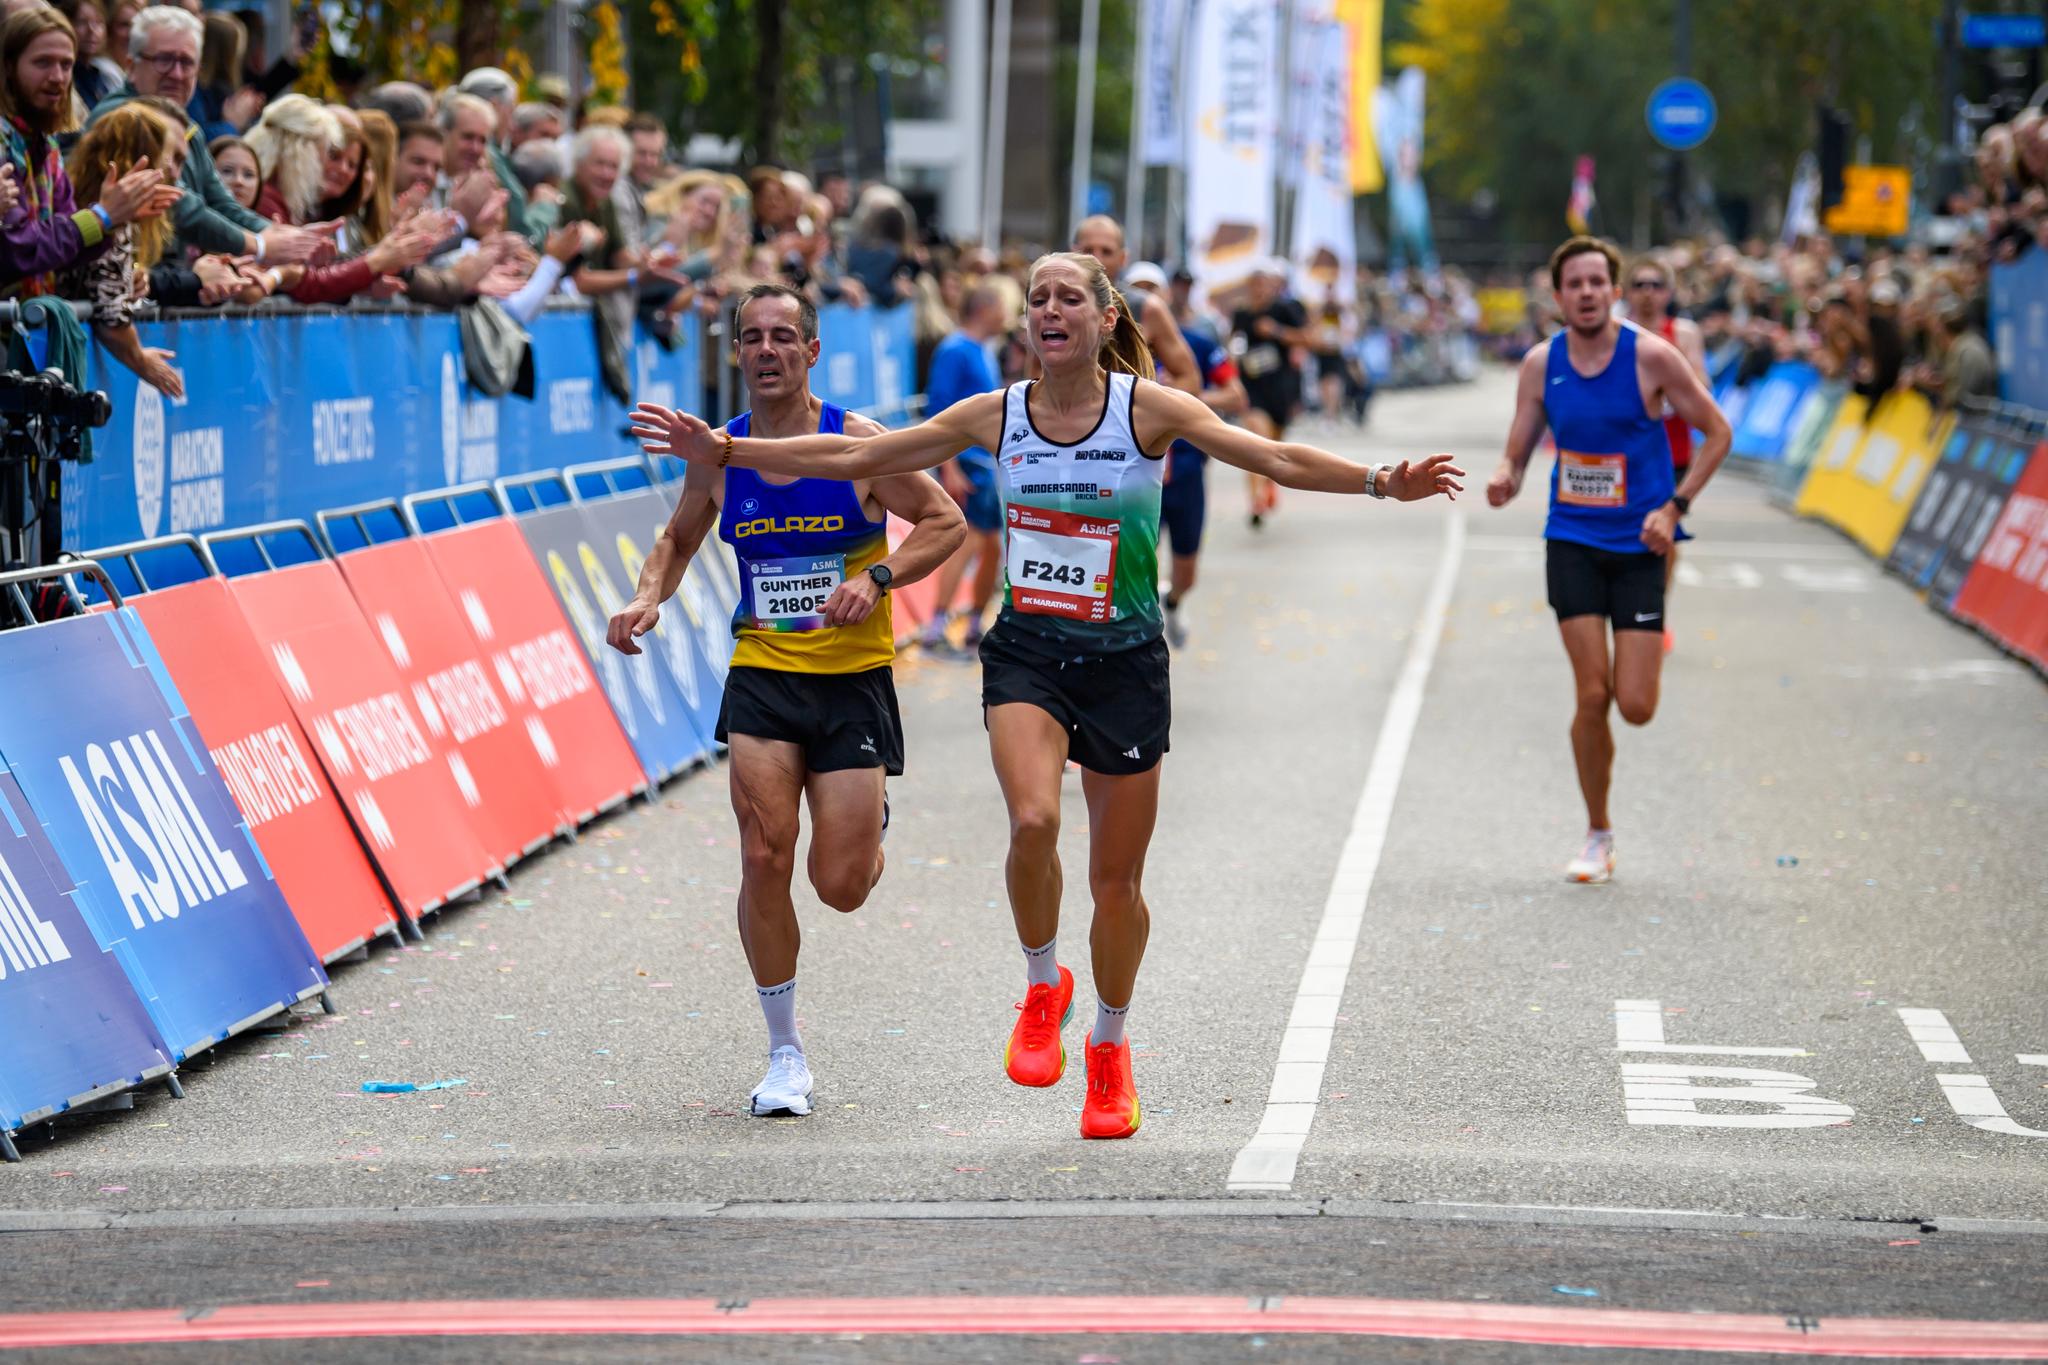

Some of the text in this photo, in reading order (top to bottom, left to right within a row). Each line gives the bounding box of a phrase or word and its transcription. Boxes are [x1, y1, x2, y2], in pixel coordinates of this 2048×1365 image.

[171, 427, 223, 481] MARATHON
[1021, 483, 1098, 494] VANDERSANDEN
[1075, 493, 1098, 501] BRICKS
[735, 515, 844, 539] GOLAZO
[811, 560, 839, 571] ASML
[1022, 559, 1085, 585] F243
[761, 576, 832, 592] GUNTHER
[769, 595, 826, 614] 21805
[1033, 598, 1077, 611] MARATHON
[427, 657, 508, 745] EINDHOVEN
[333, 690, 433, 782] EINDHOVEN
[58, 729, 249, 930] ASML
[0, 853, 72, 981] ML
